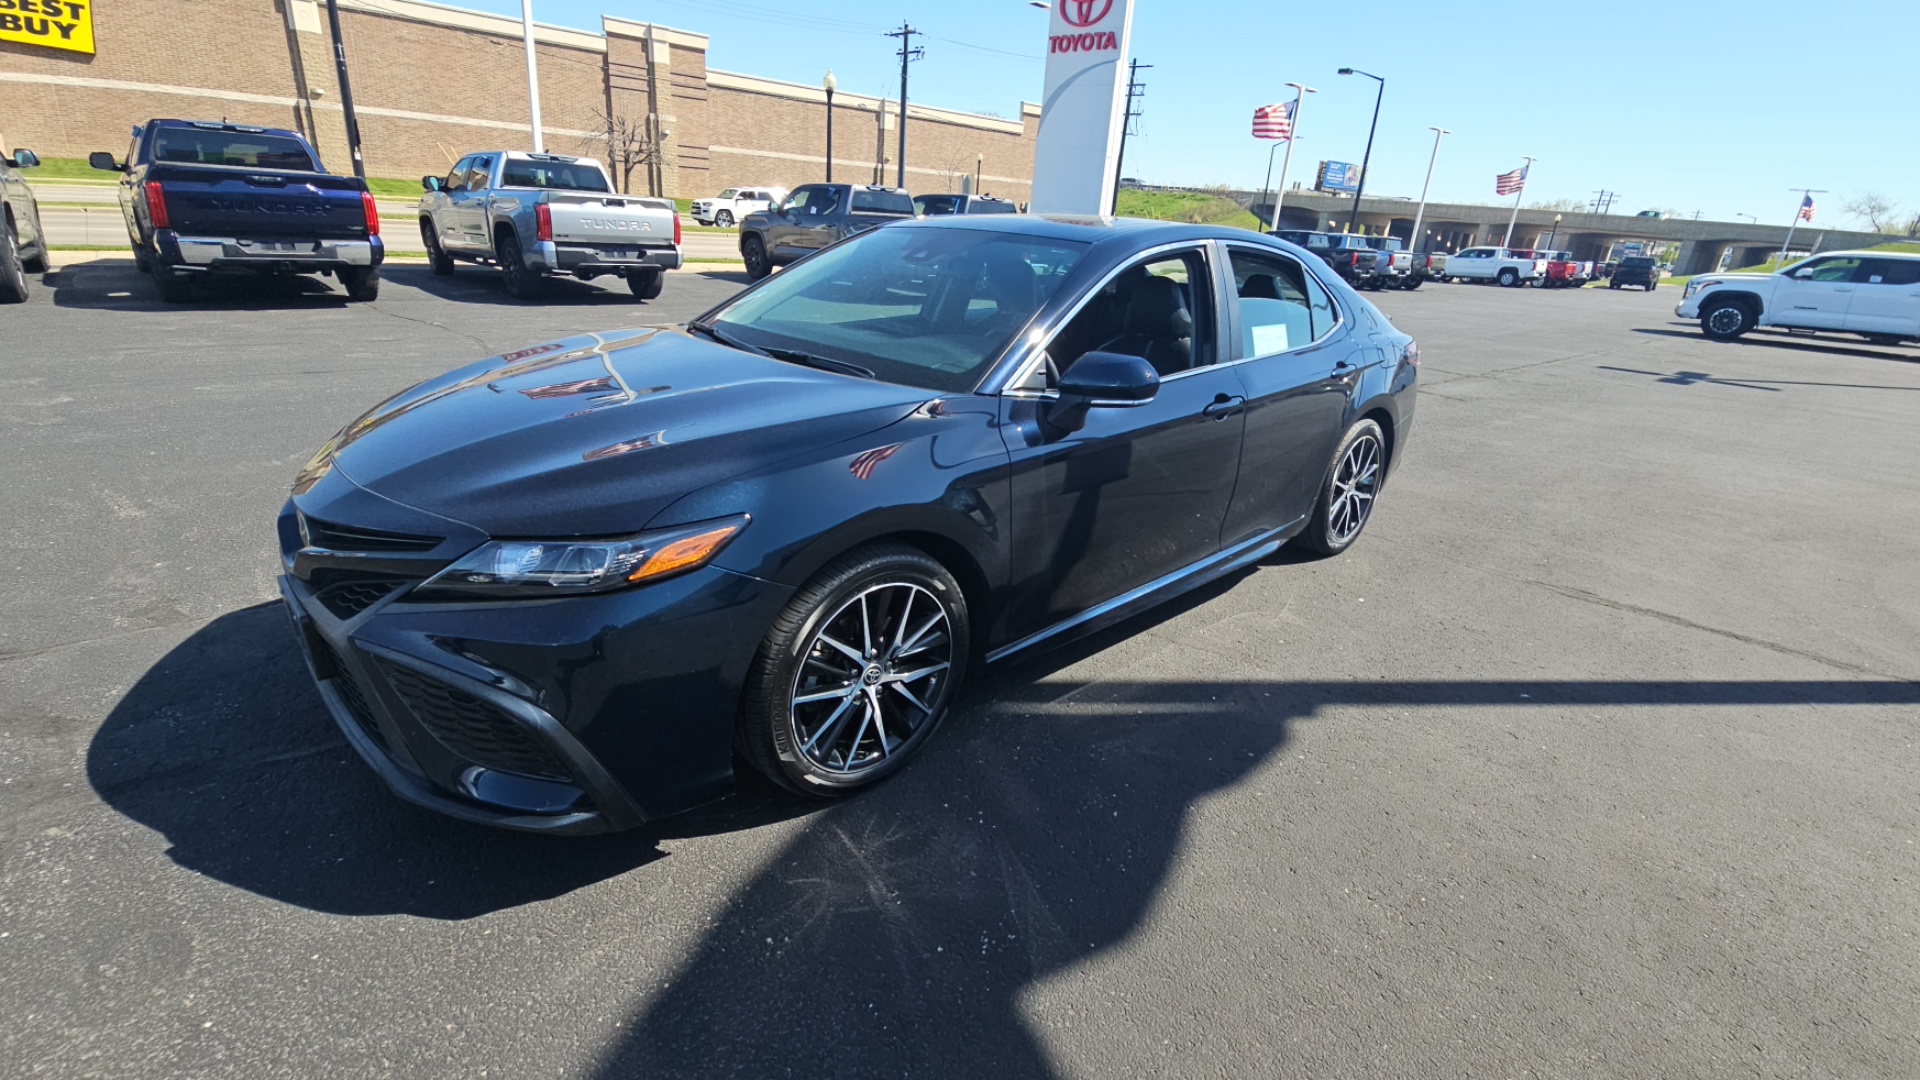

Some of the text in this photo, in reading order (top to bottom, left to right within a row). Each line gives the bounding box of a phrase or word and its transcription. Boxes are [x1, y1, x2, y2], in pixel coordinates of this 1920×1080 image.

[0, 13, 78, 40] BUY
[1049, 31, 1118, 54] TOYOTA
[211, 199, 332, 217] TUNDRA
[579, 218, 653, 232] TUNDRA
